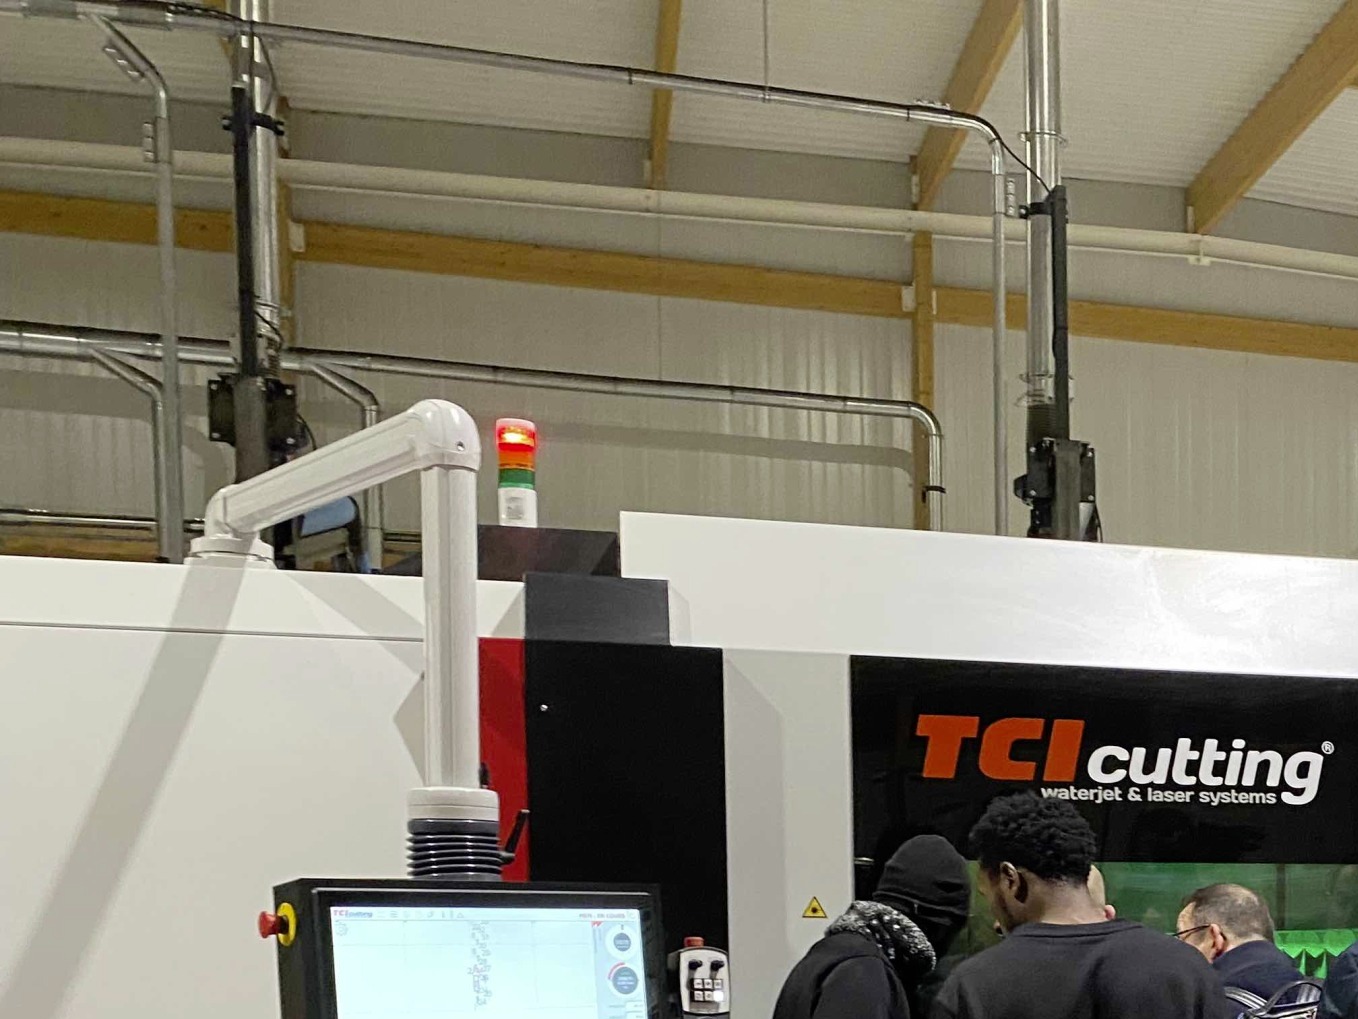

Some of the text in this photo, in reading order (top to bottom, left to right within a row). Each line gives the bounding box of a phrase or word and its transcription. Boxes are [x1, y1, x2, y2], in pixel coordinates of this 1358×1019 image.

[916, 714, 1085, 782] TCI
[1041, 786, 1277, 806] waterjet & laser systems
